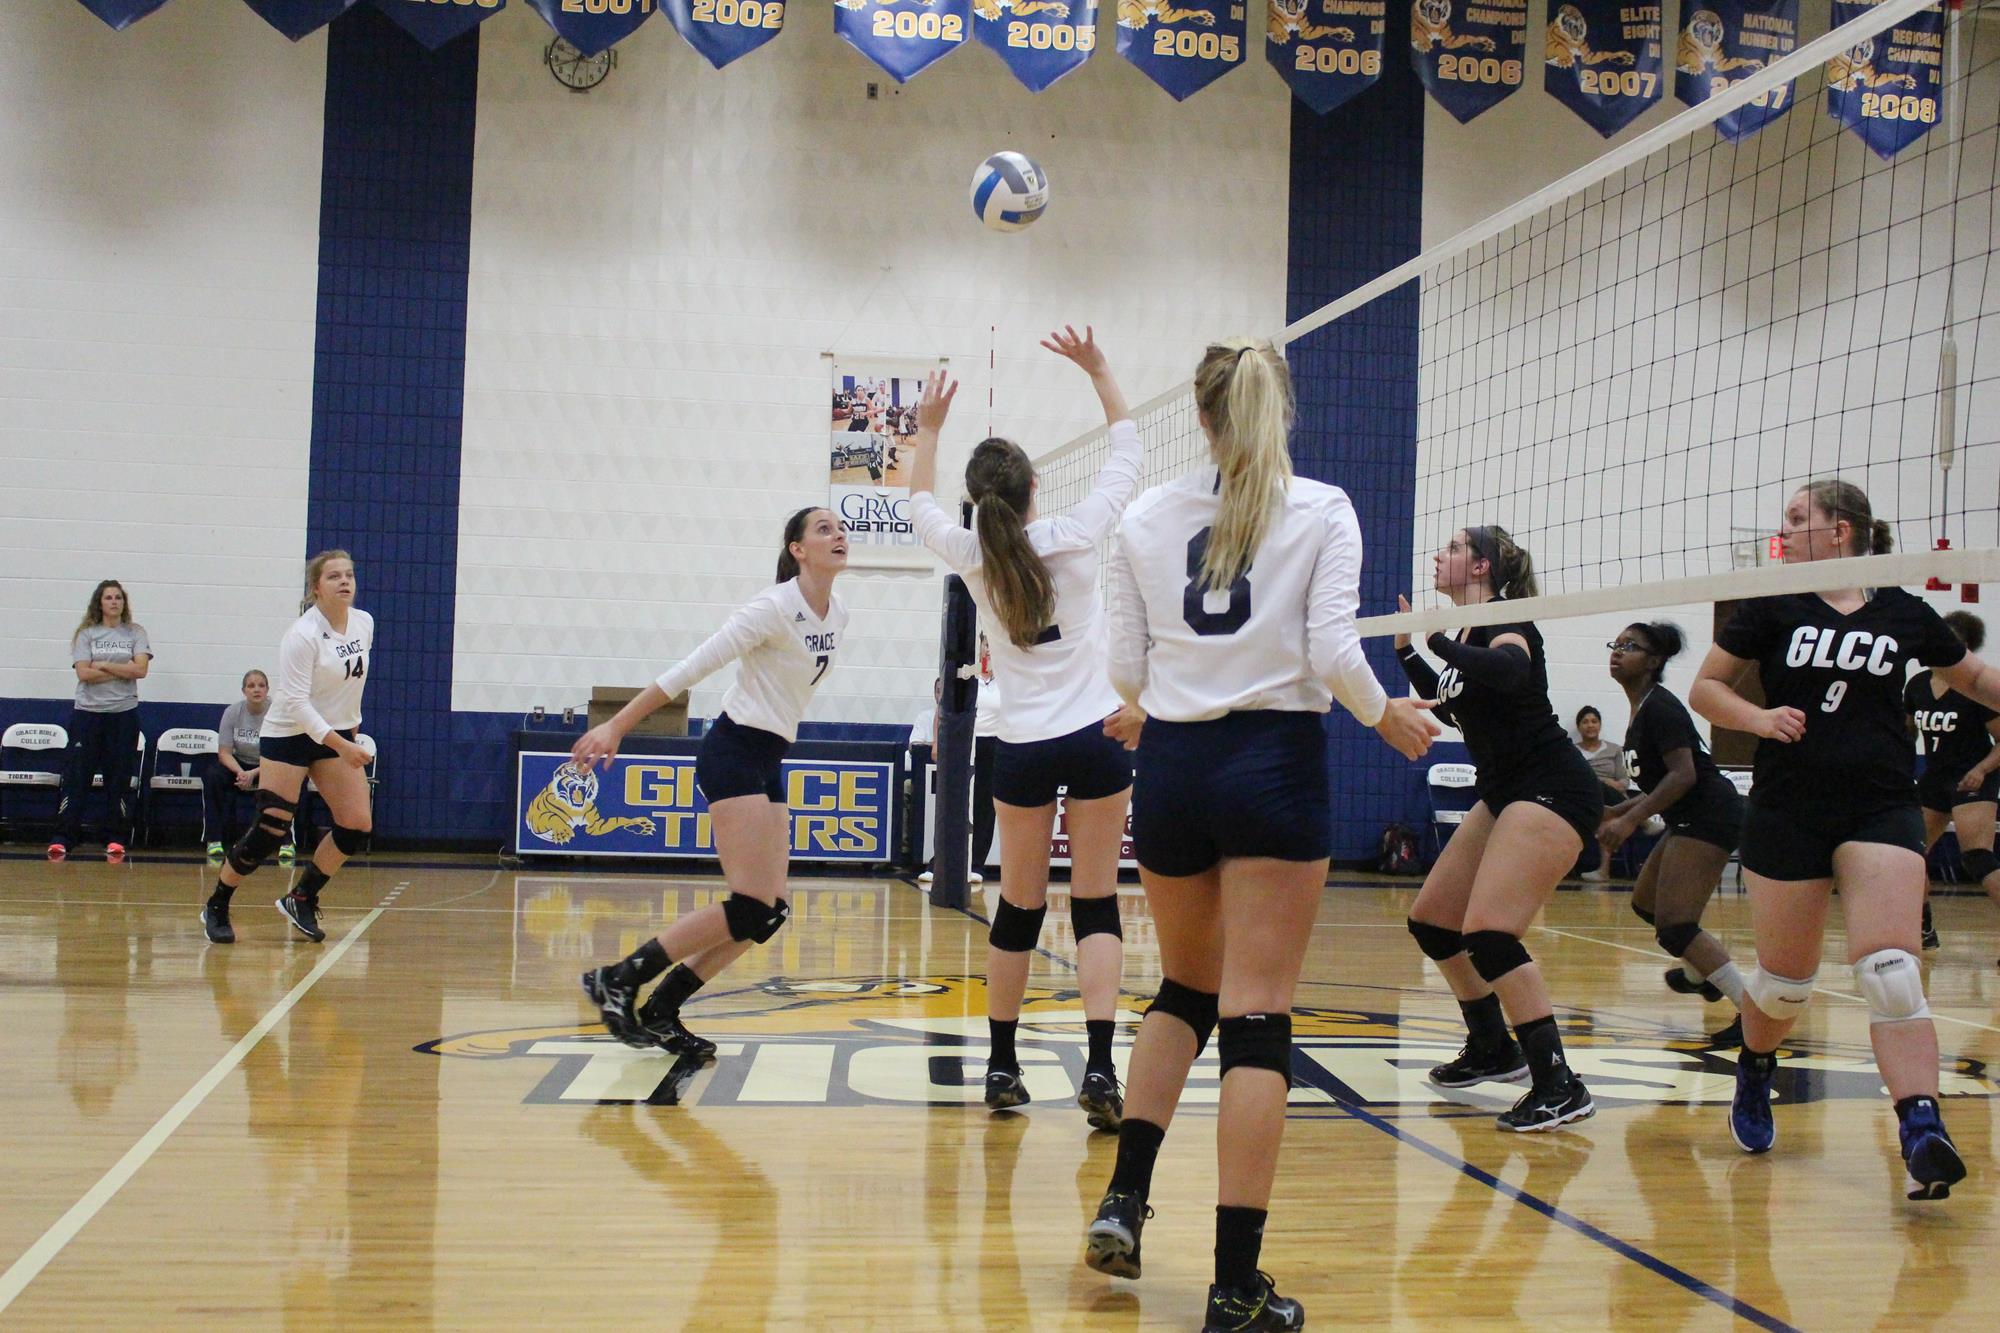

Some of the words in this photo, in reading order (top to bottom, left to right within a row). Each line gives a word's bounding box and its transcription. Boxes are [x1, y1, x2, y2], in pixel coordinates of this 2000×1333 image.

[693, 0, 784, 29] 2002
[873, 11, 963, 42] 2002
[1620, 6, 1661, 22] ELITE
[1743, 13, 1795, 35] NATIONAL
[1008, 21, 1096, 51] 2005
[1153, 29, 1240, 62] 2005
[1623, 24, 1661, 40] EIGHT
[1739, 31, 1778, 50] RUNNER
[1780, 37, 1795, 52] UP
[1892, 28, 1942, 49] REGIONAL
[1295, 45, 1382, 76] 2006
[1438, 54, 1522, 85] 2006
[1580, 69, 1657, 99] 2007
[1710, 76, 1788, 109] 27
[1861, 92, 1936, 123] 2008
[840, 493, 912, 520] GRAC
[1183, 525, 1253, 637] 8
[95, 640, 134, 649] GRACE
[335, 639, 365, 658] GRACE
[804, 631, 836, 652] GRACE
[1785, 625, 1899, 676] GLCC
[343, 655, 364, 681] 14
[809, 654, 829, 686] 7
[1820, 680, 1848, 713] 9
[15, 729, 38, 737] GRACE
[238, 728, 260, 738] GRA
[1914, 709, 1959, 733] GLCC
[1931, 736, 1940, 753] 7
[624, 764, 880, 813] GCE
[651, 811, 879, 852] TIRS
[518, 1040, 1790, 1104] TIGRS
